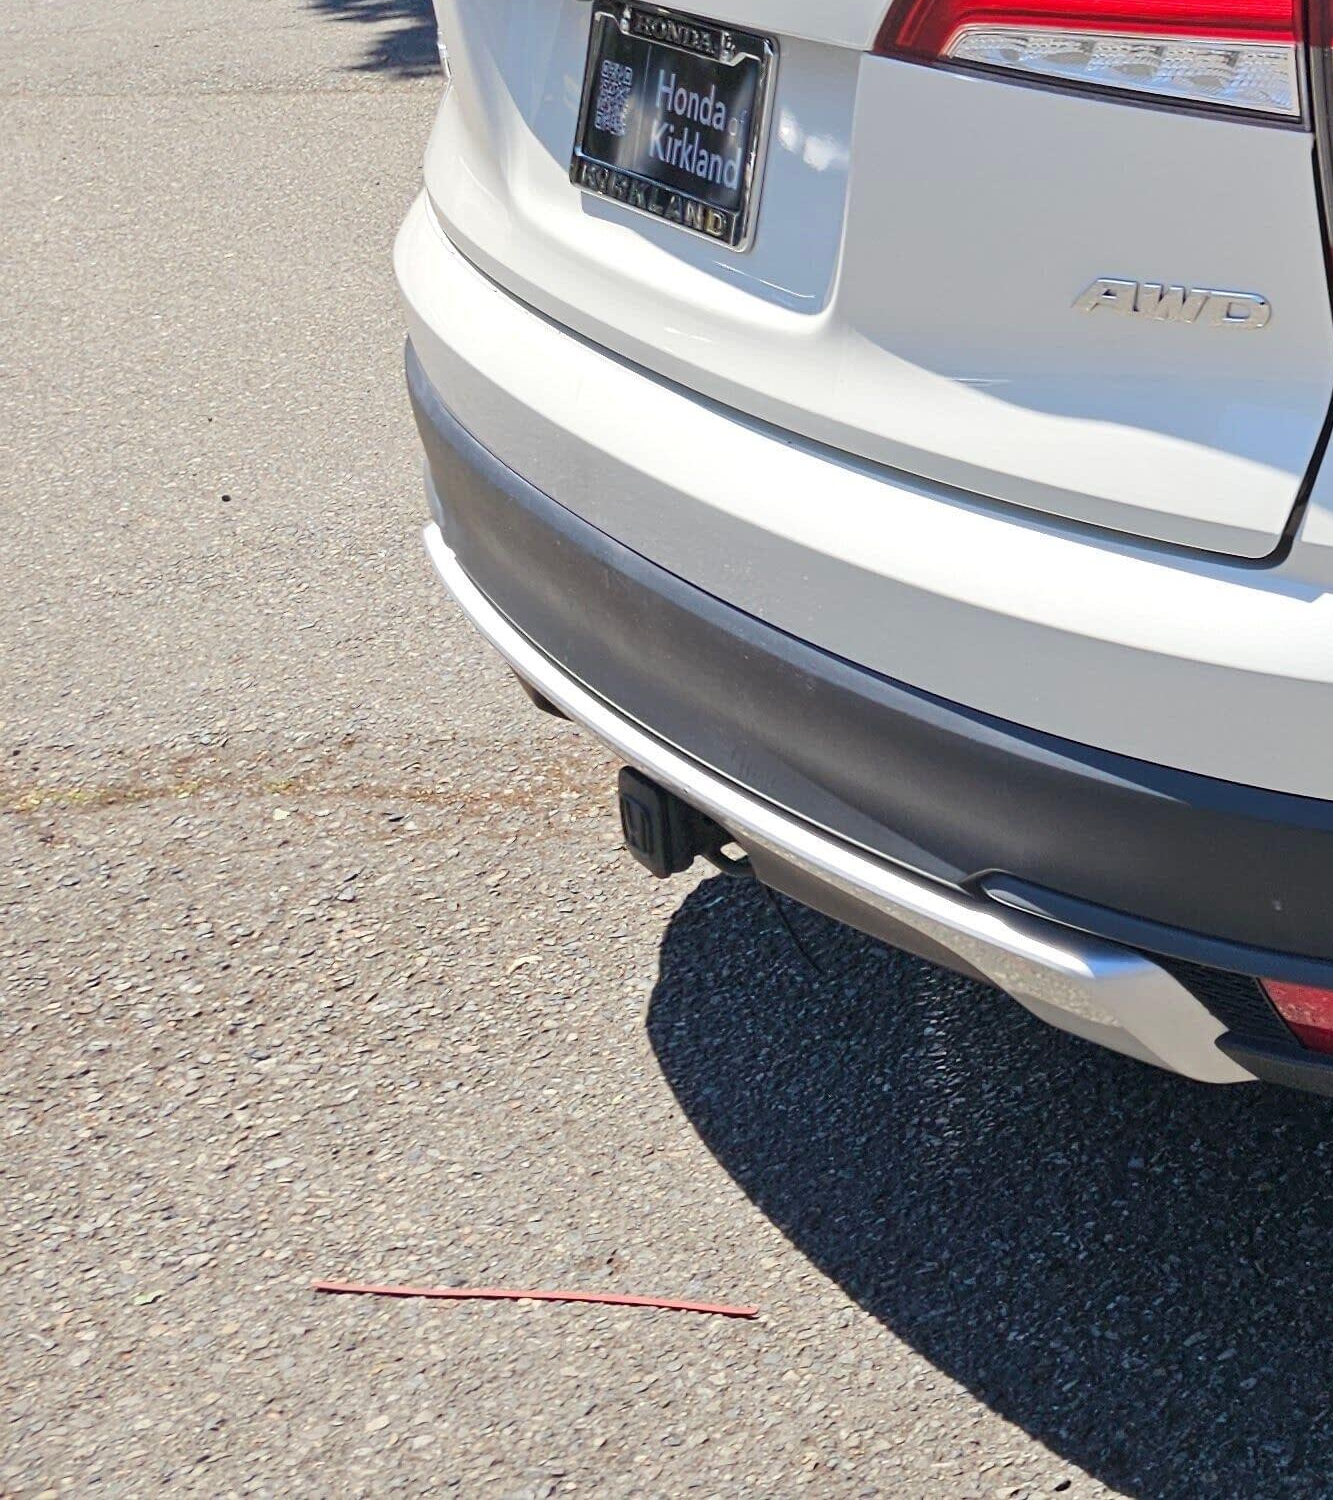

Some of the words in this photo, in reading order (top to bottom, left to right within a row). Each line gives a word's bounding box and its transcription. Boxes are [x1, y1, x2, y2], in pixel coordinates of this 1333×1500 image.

[633, 12, 716, 55] HONDA
[655, 68, 727, 129] Honda
[727, 108, 749, 137] of
[649, 119, 742, 190] Kirkland
[580, 164, 727, 237] KIRKLAND
[1070, 277, 1273, 331] AWD
